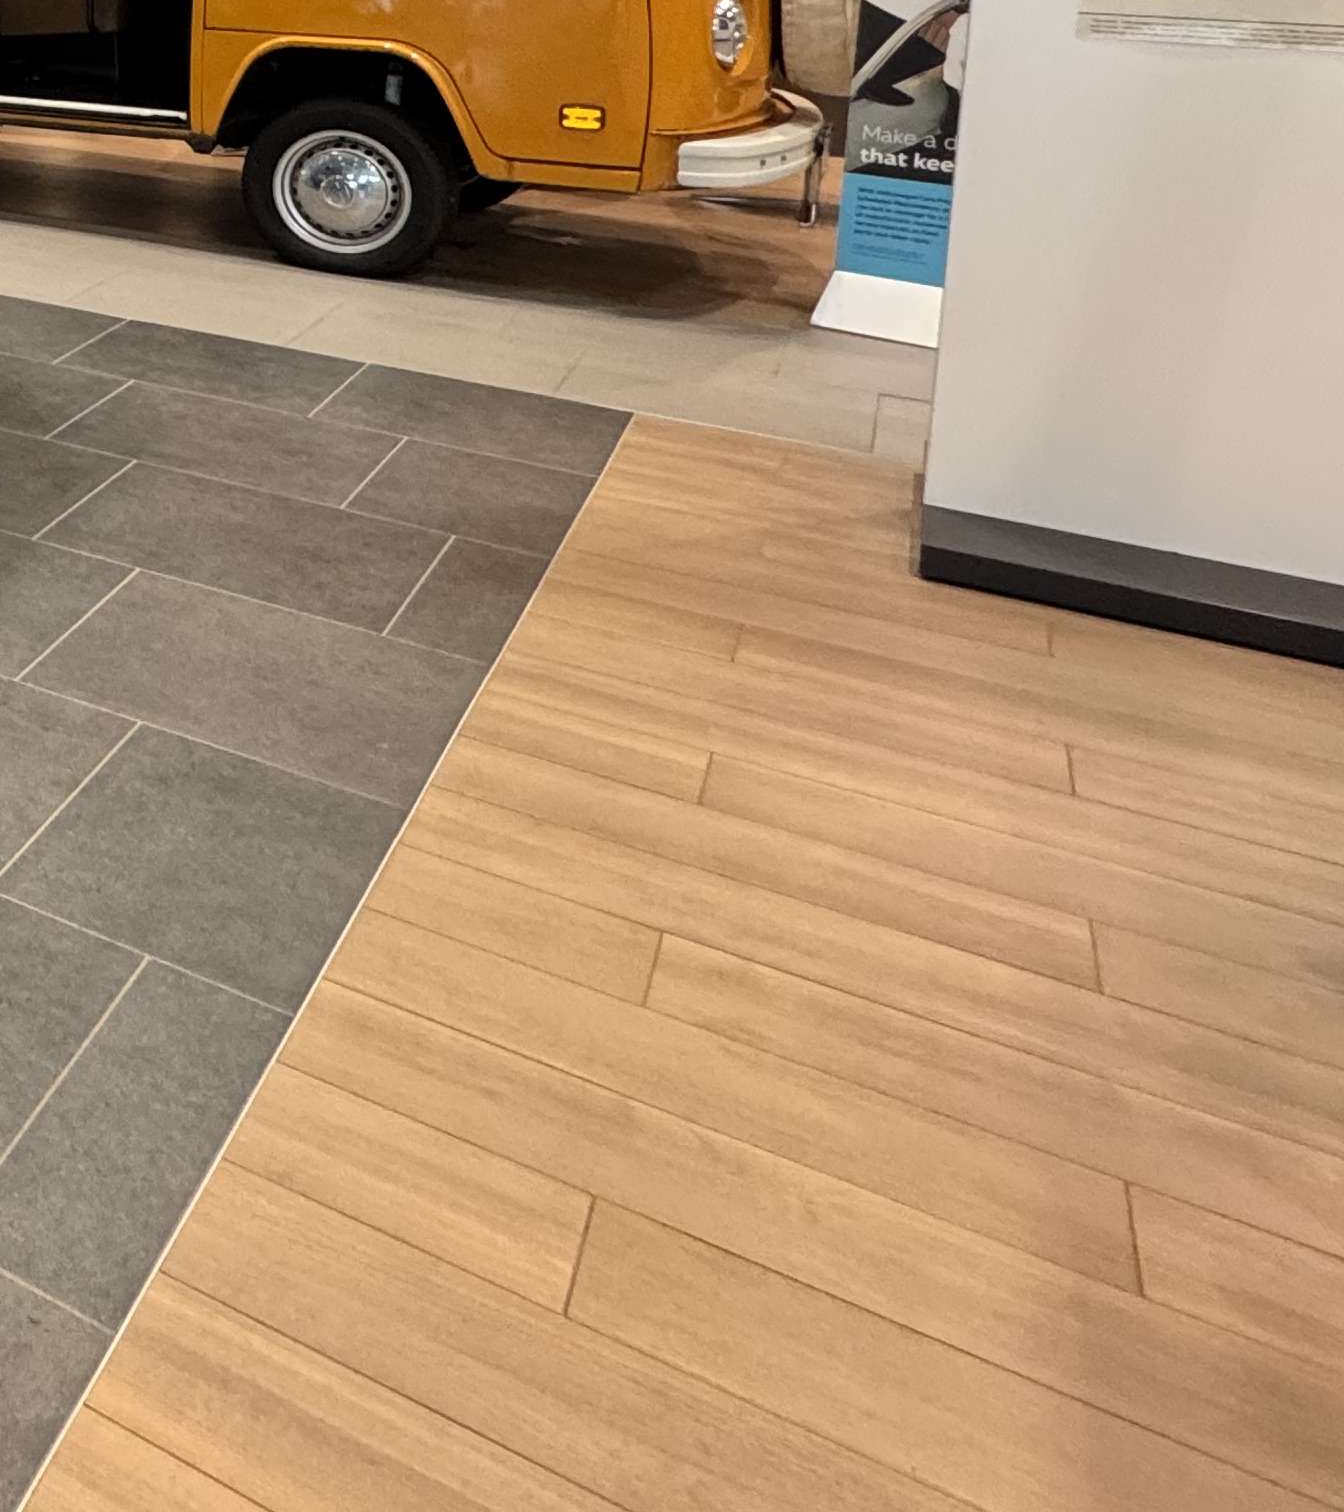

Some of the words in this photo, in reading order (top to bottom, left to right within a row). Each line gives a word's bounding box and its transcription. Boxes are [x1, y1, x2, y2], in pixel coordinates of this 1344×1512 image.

[862, 124, 917, 145] Make
[923, 135, 936, 149] a
[860, 147, 909, 168] that
[913, 152, 955, 173] kee
